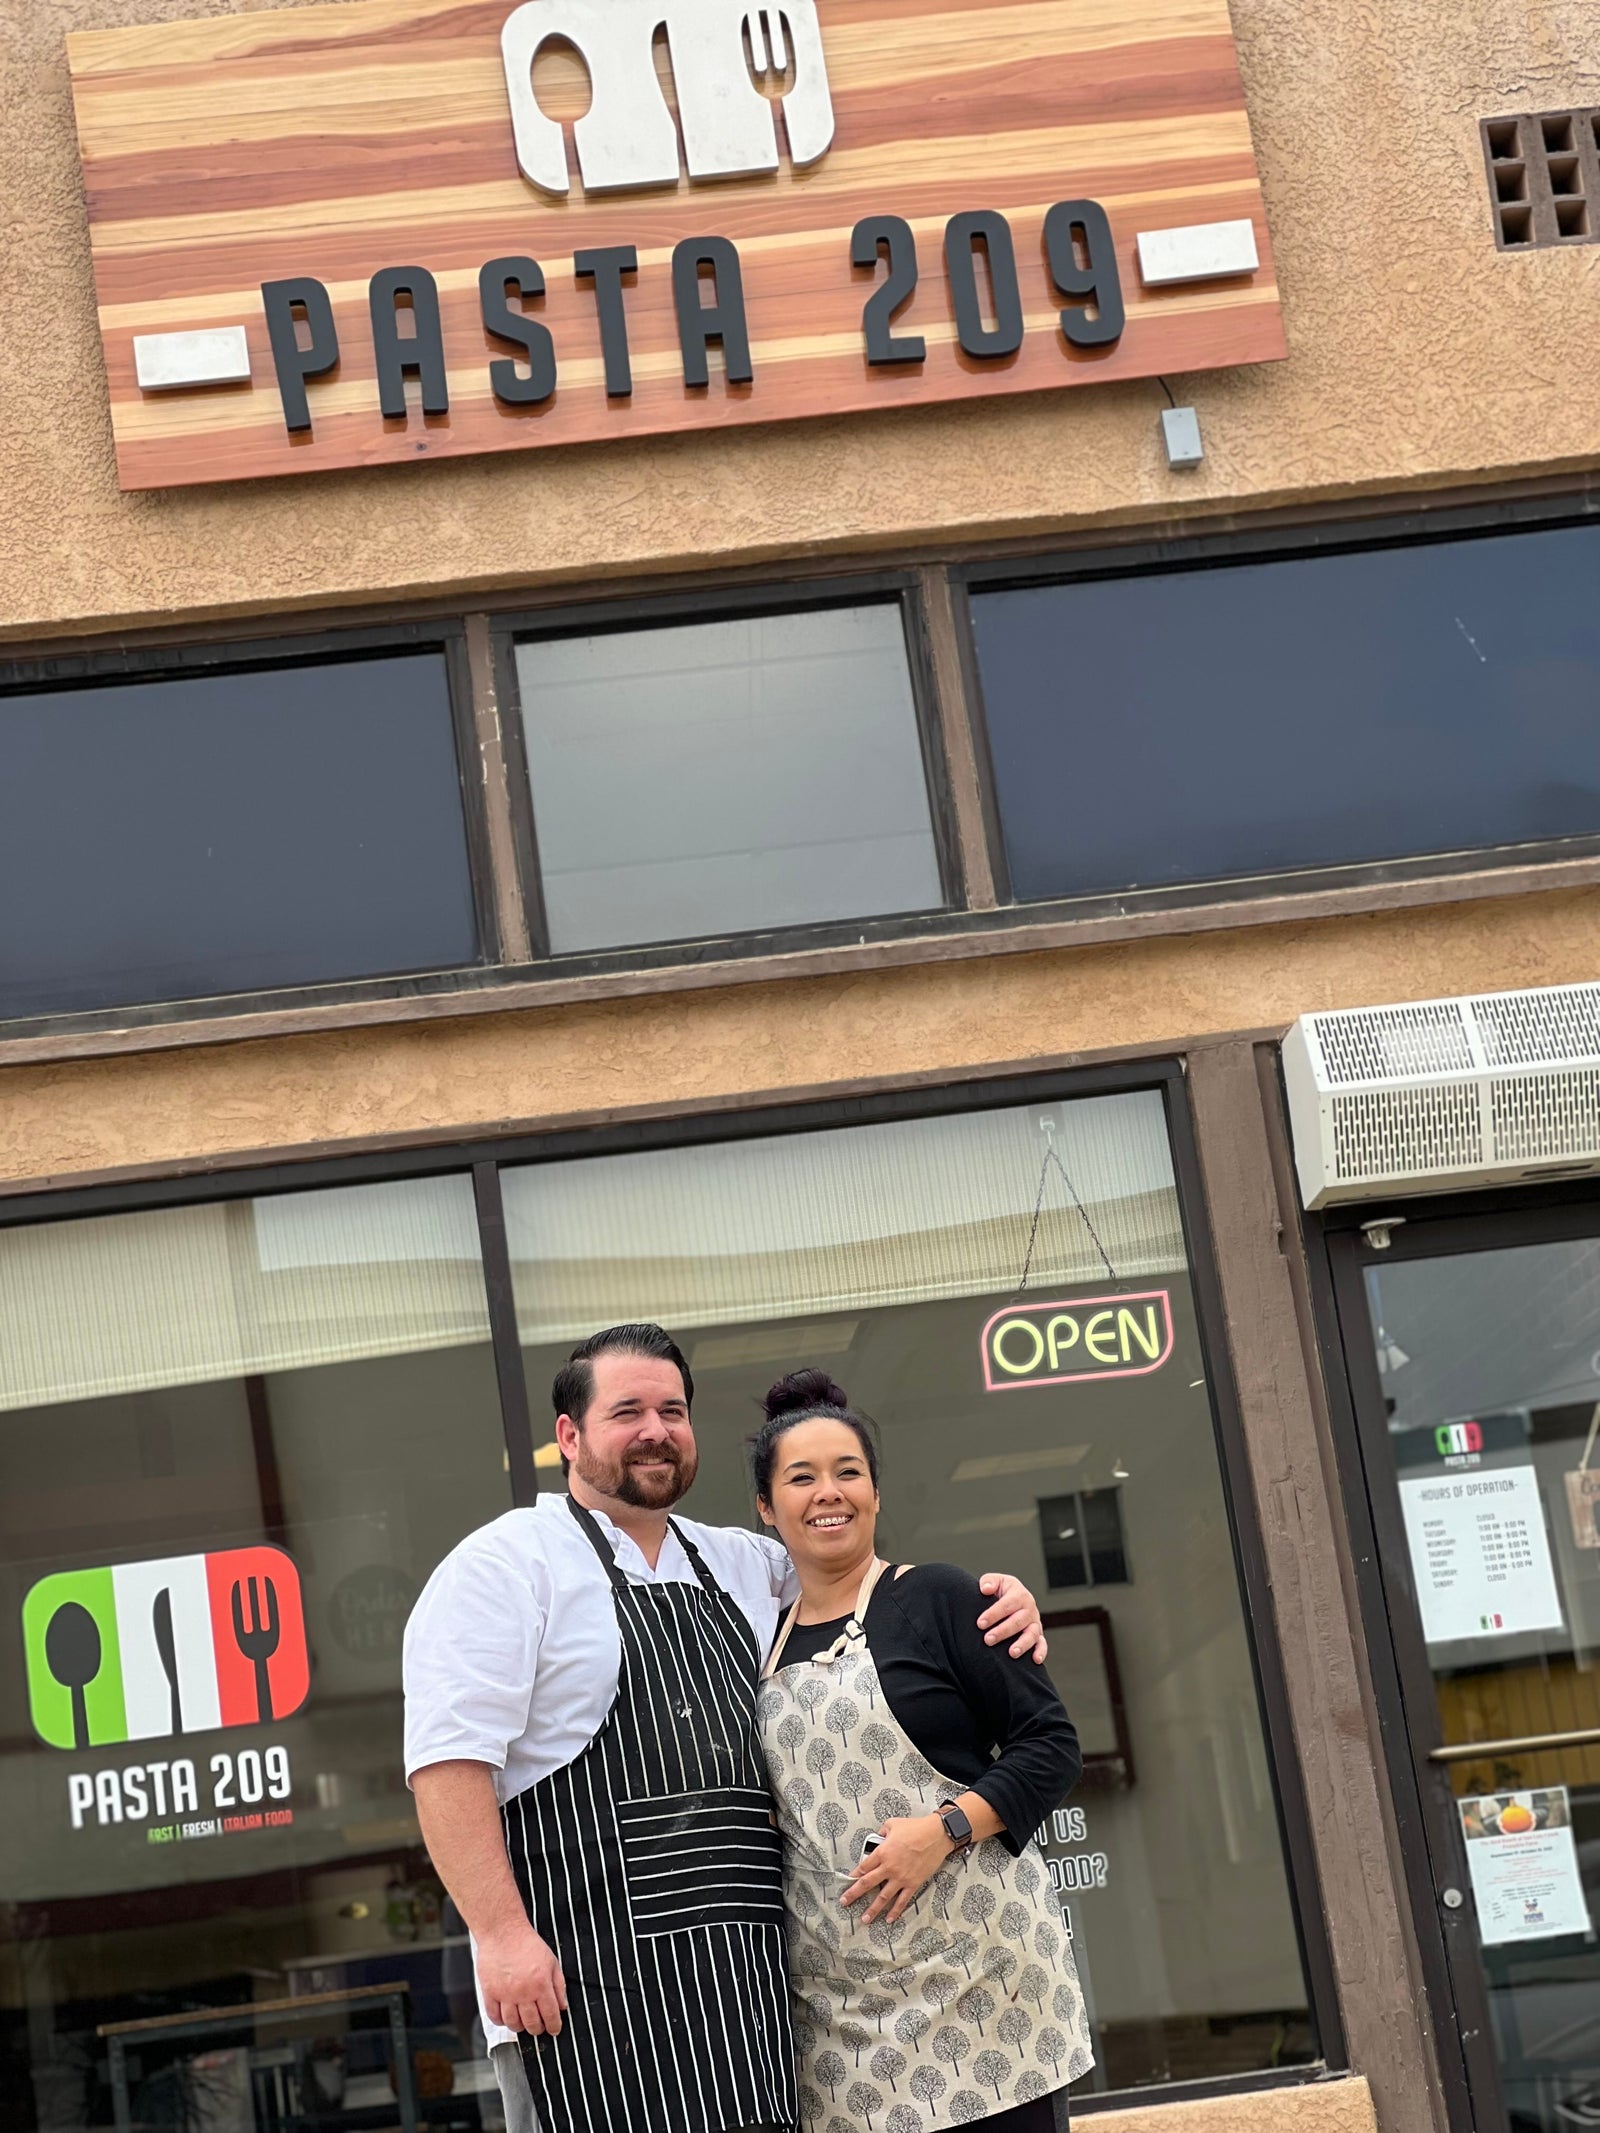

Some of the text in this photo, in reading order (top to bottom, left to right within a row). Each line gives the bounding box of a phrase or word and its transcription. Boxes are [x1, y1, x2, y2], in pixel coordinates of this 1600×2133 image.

[260, 199, 1125, 432] PASTA 209
[993, 1305, 1159, 1374] OPEN
[1453, 1484, 1463, 1498] OF
[346, 1620, 399, 1649] HER
[68, 1746, 291, 1829] PASTA 209
[147, 1825, 174, 1844] FAST
[182, 1820, 216, 1839] FRESH
[224, 1814, 262, 1832] ITALIAN
[265, 1809, 293, 1827] FOOD
[1053, 1808, 1087, 1842] US
[1046, 1852, 1108, 1892] OOD?
